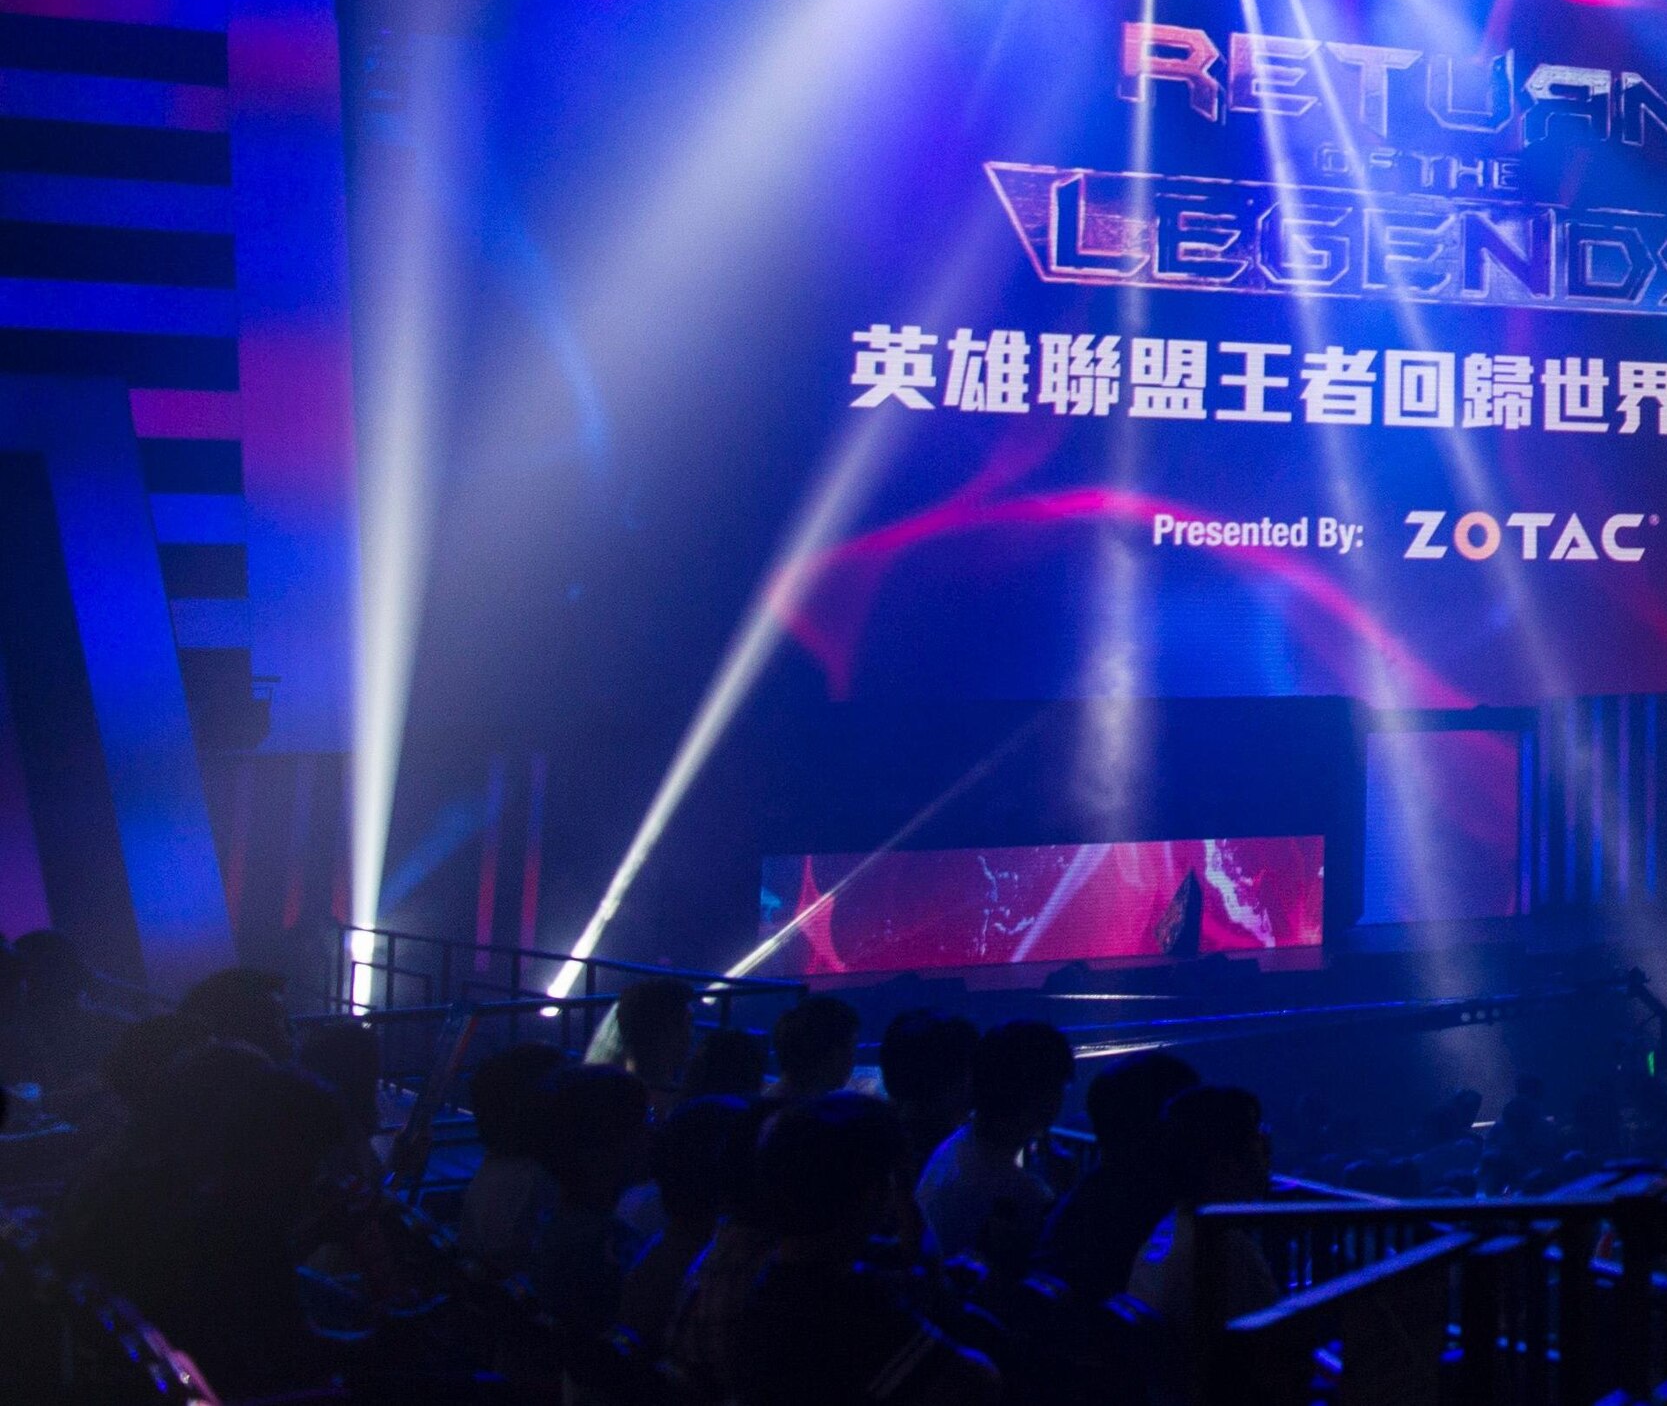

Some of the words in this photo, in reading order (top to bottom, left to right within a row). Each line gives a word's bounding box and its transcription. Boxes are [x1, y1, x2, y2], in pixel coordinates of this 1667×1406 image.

[1412, 151, 1521, 190] THE
[1153, 513, 1308, 548] Presented
[1318, 517, 1365, 555] By:
[1404, 510, 1647, 562] ZOTAC
